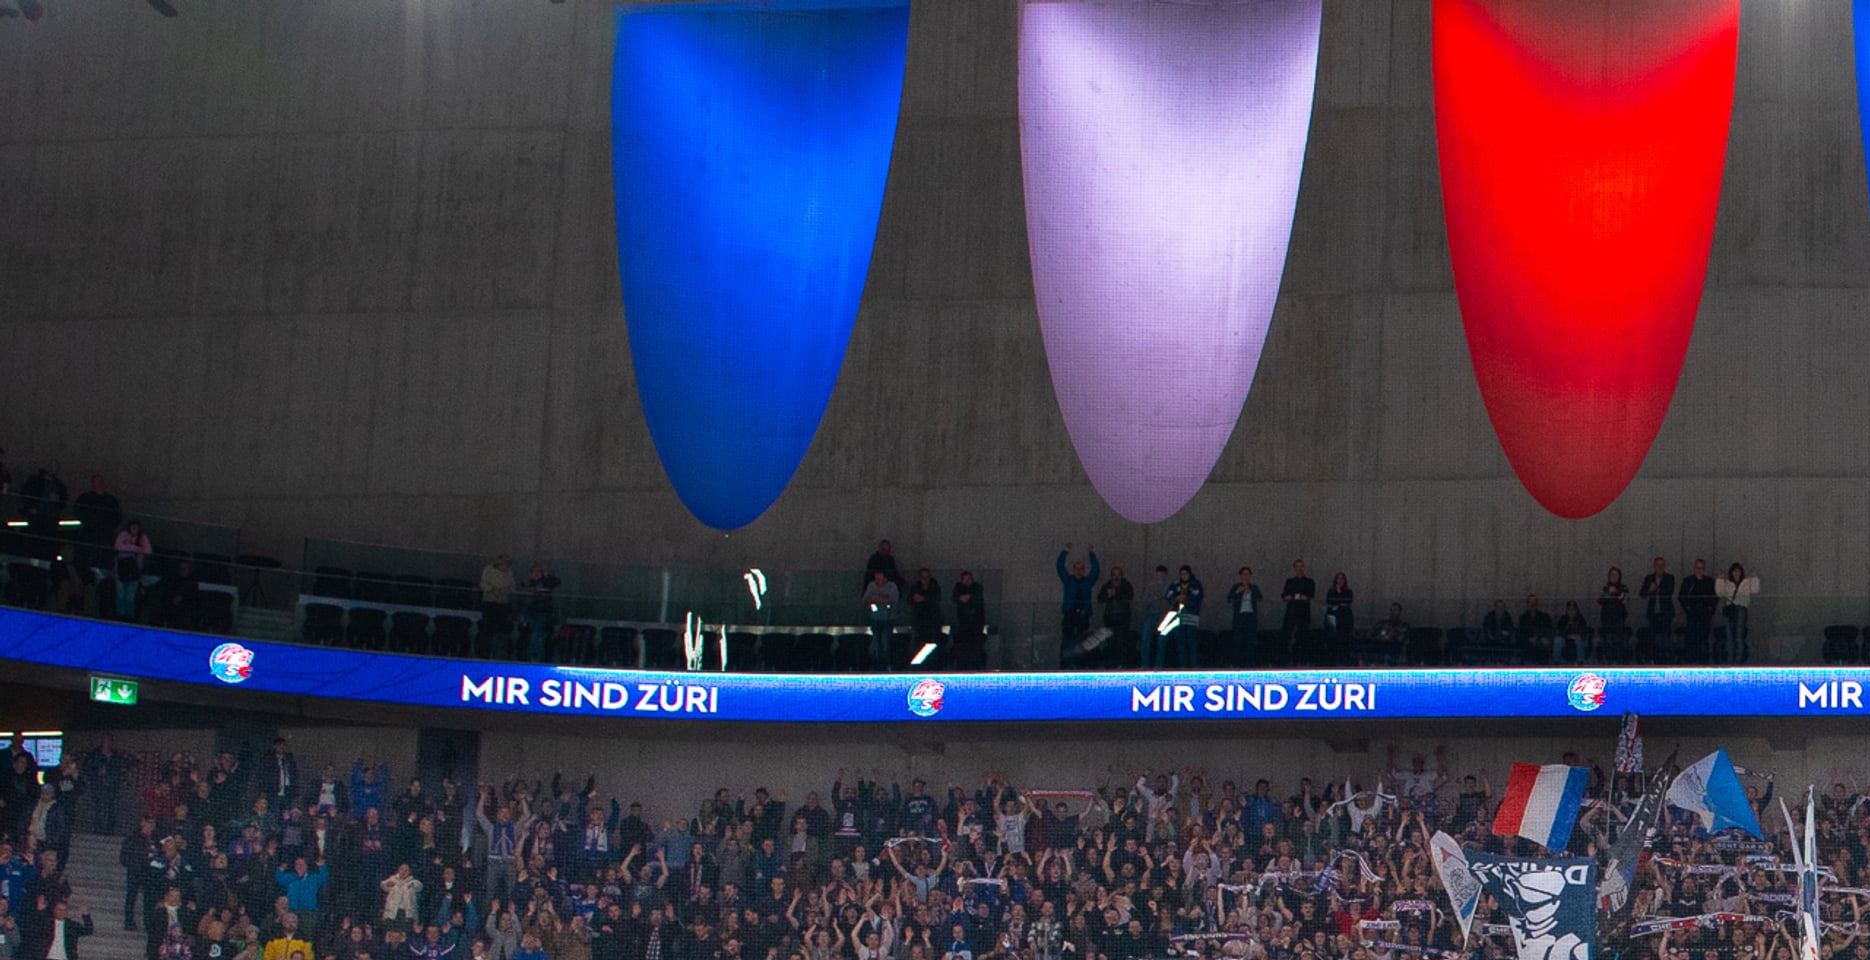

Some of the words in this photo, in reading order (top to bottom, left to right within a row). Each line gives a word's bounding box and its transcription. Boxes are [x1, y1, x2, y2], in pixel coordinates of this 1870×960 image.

[461, 676, 529, 706] MIR
[541, 679, 628, 711] SIND
[636, 680, 718, 713] ZÜRI
[1131, 685, 1195, 713] MIR
[1204, 684, 1288, 712] SIND
[1295, 679, 1375, 711] ZÜRI
[1799, 682, 1863, 708] MIR
